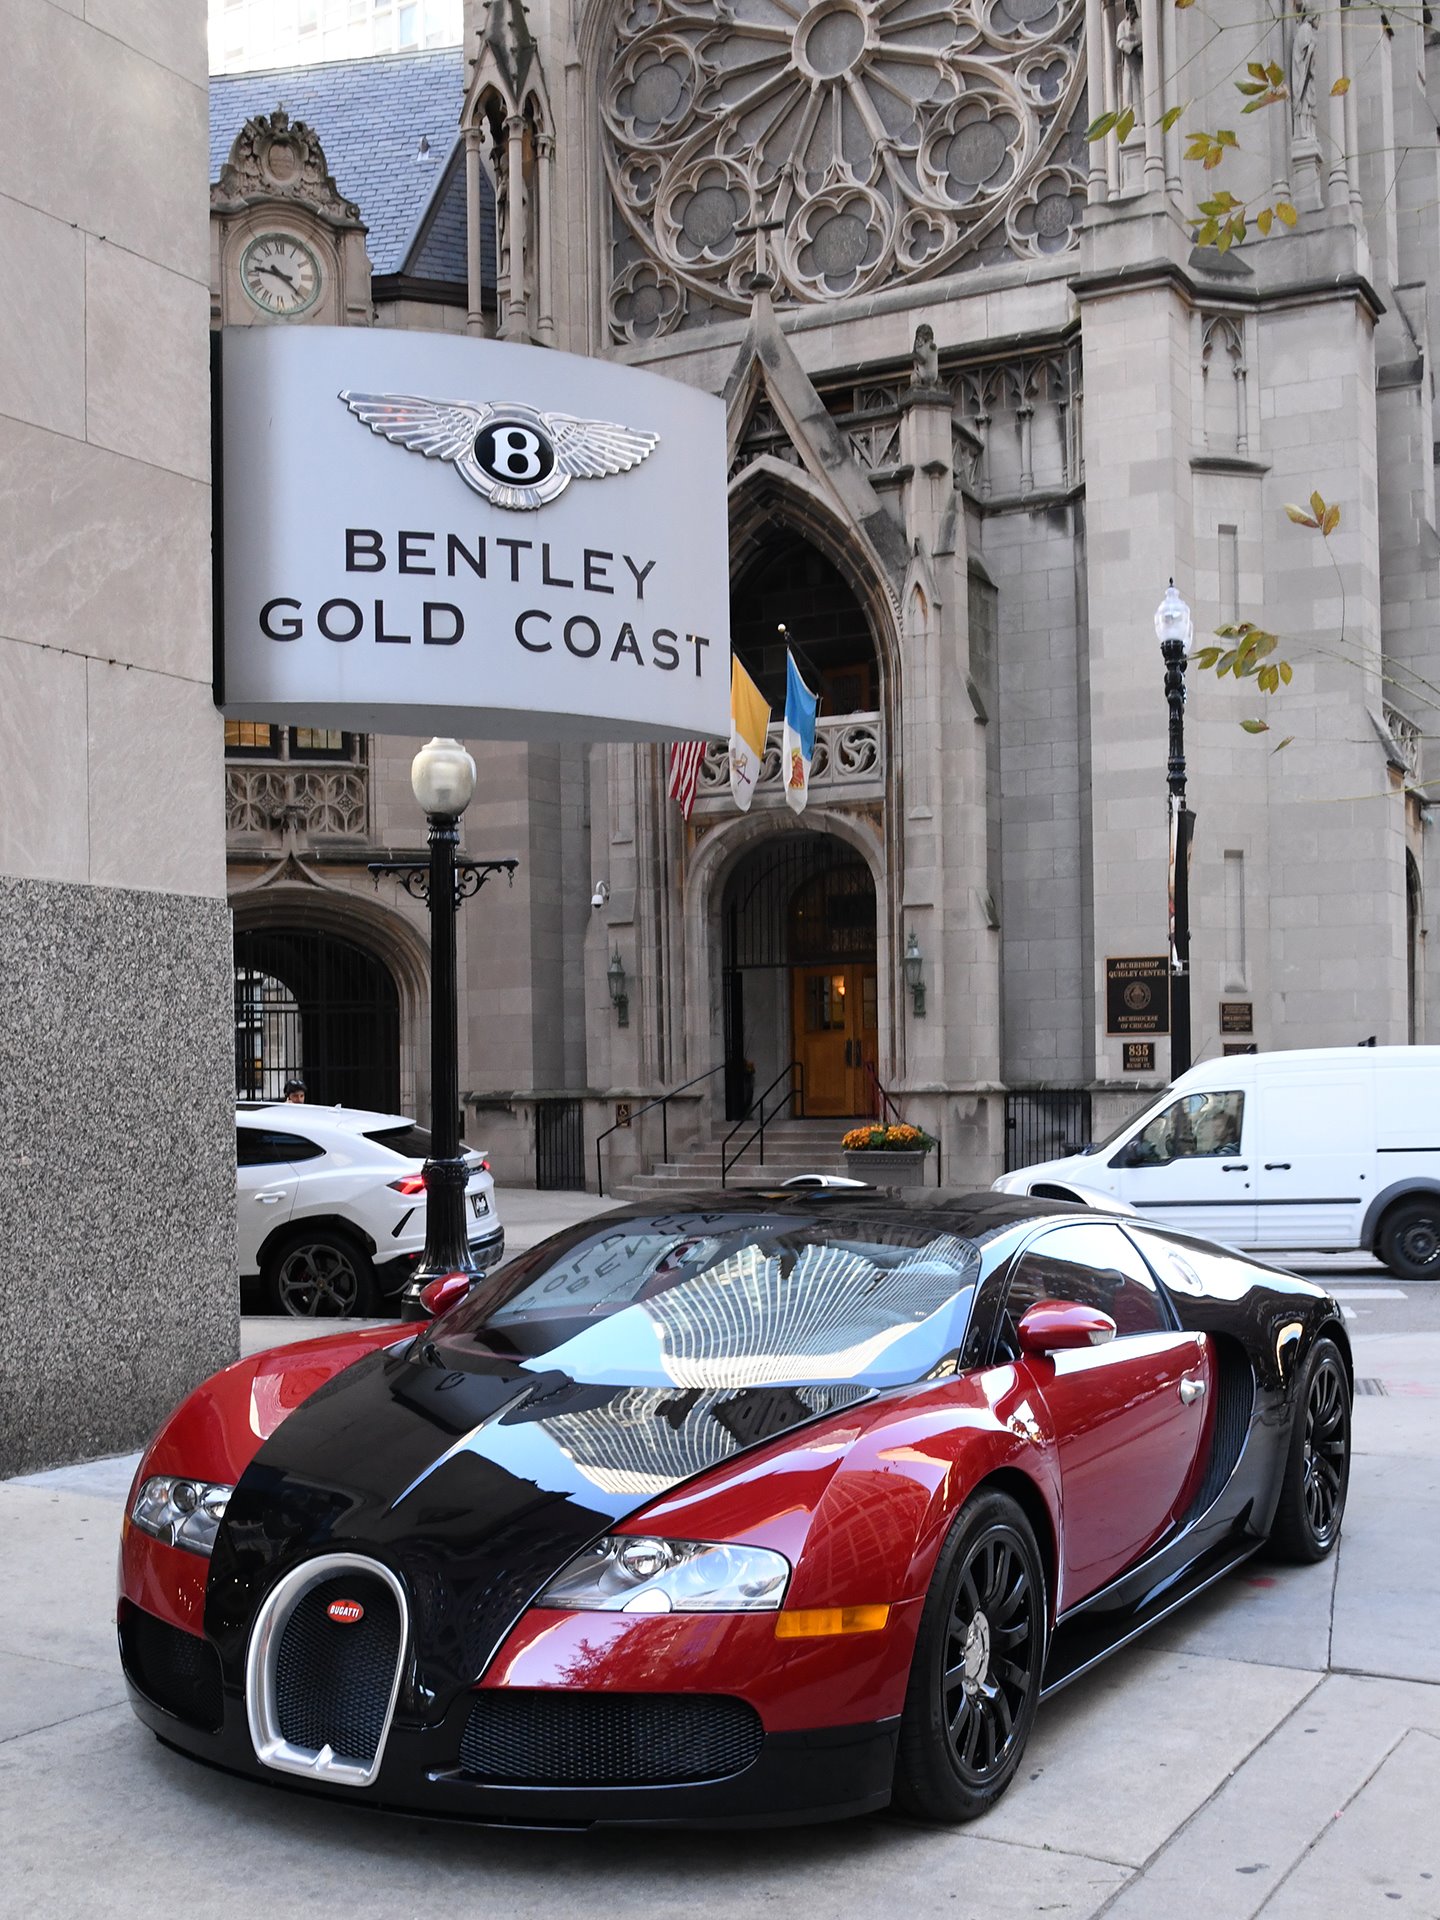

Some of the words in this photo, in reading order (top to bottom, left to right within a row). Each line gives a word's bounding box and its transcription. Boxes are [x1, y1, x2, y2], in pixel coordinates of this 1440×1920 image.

[491, 427, 541, 480] B
[344, 528, 656, 600] BENTLEY
[258, 597, 466, 646] GOLD
[514, 609, 710, 678] COAST
[1115, 961, 1160, 969] ARCHBISHOP
[1108, 969, 1138, 979] QUIGLEY
[1138, 968, 1167, 977] CENTER
[1128, 1044, 1149, 1056] 835
[330, 1605, 359, 1617] BUGATTI
